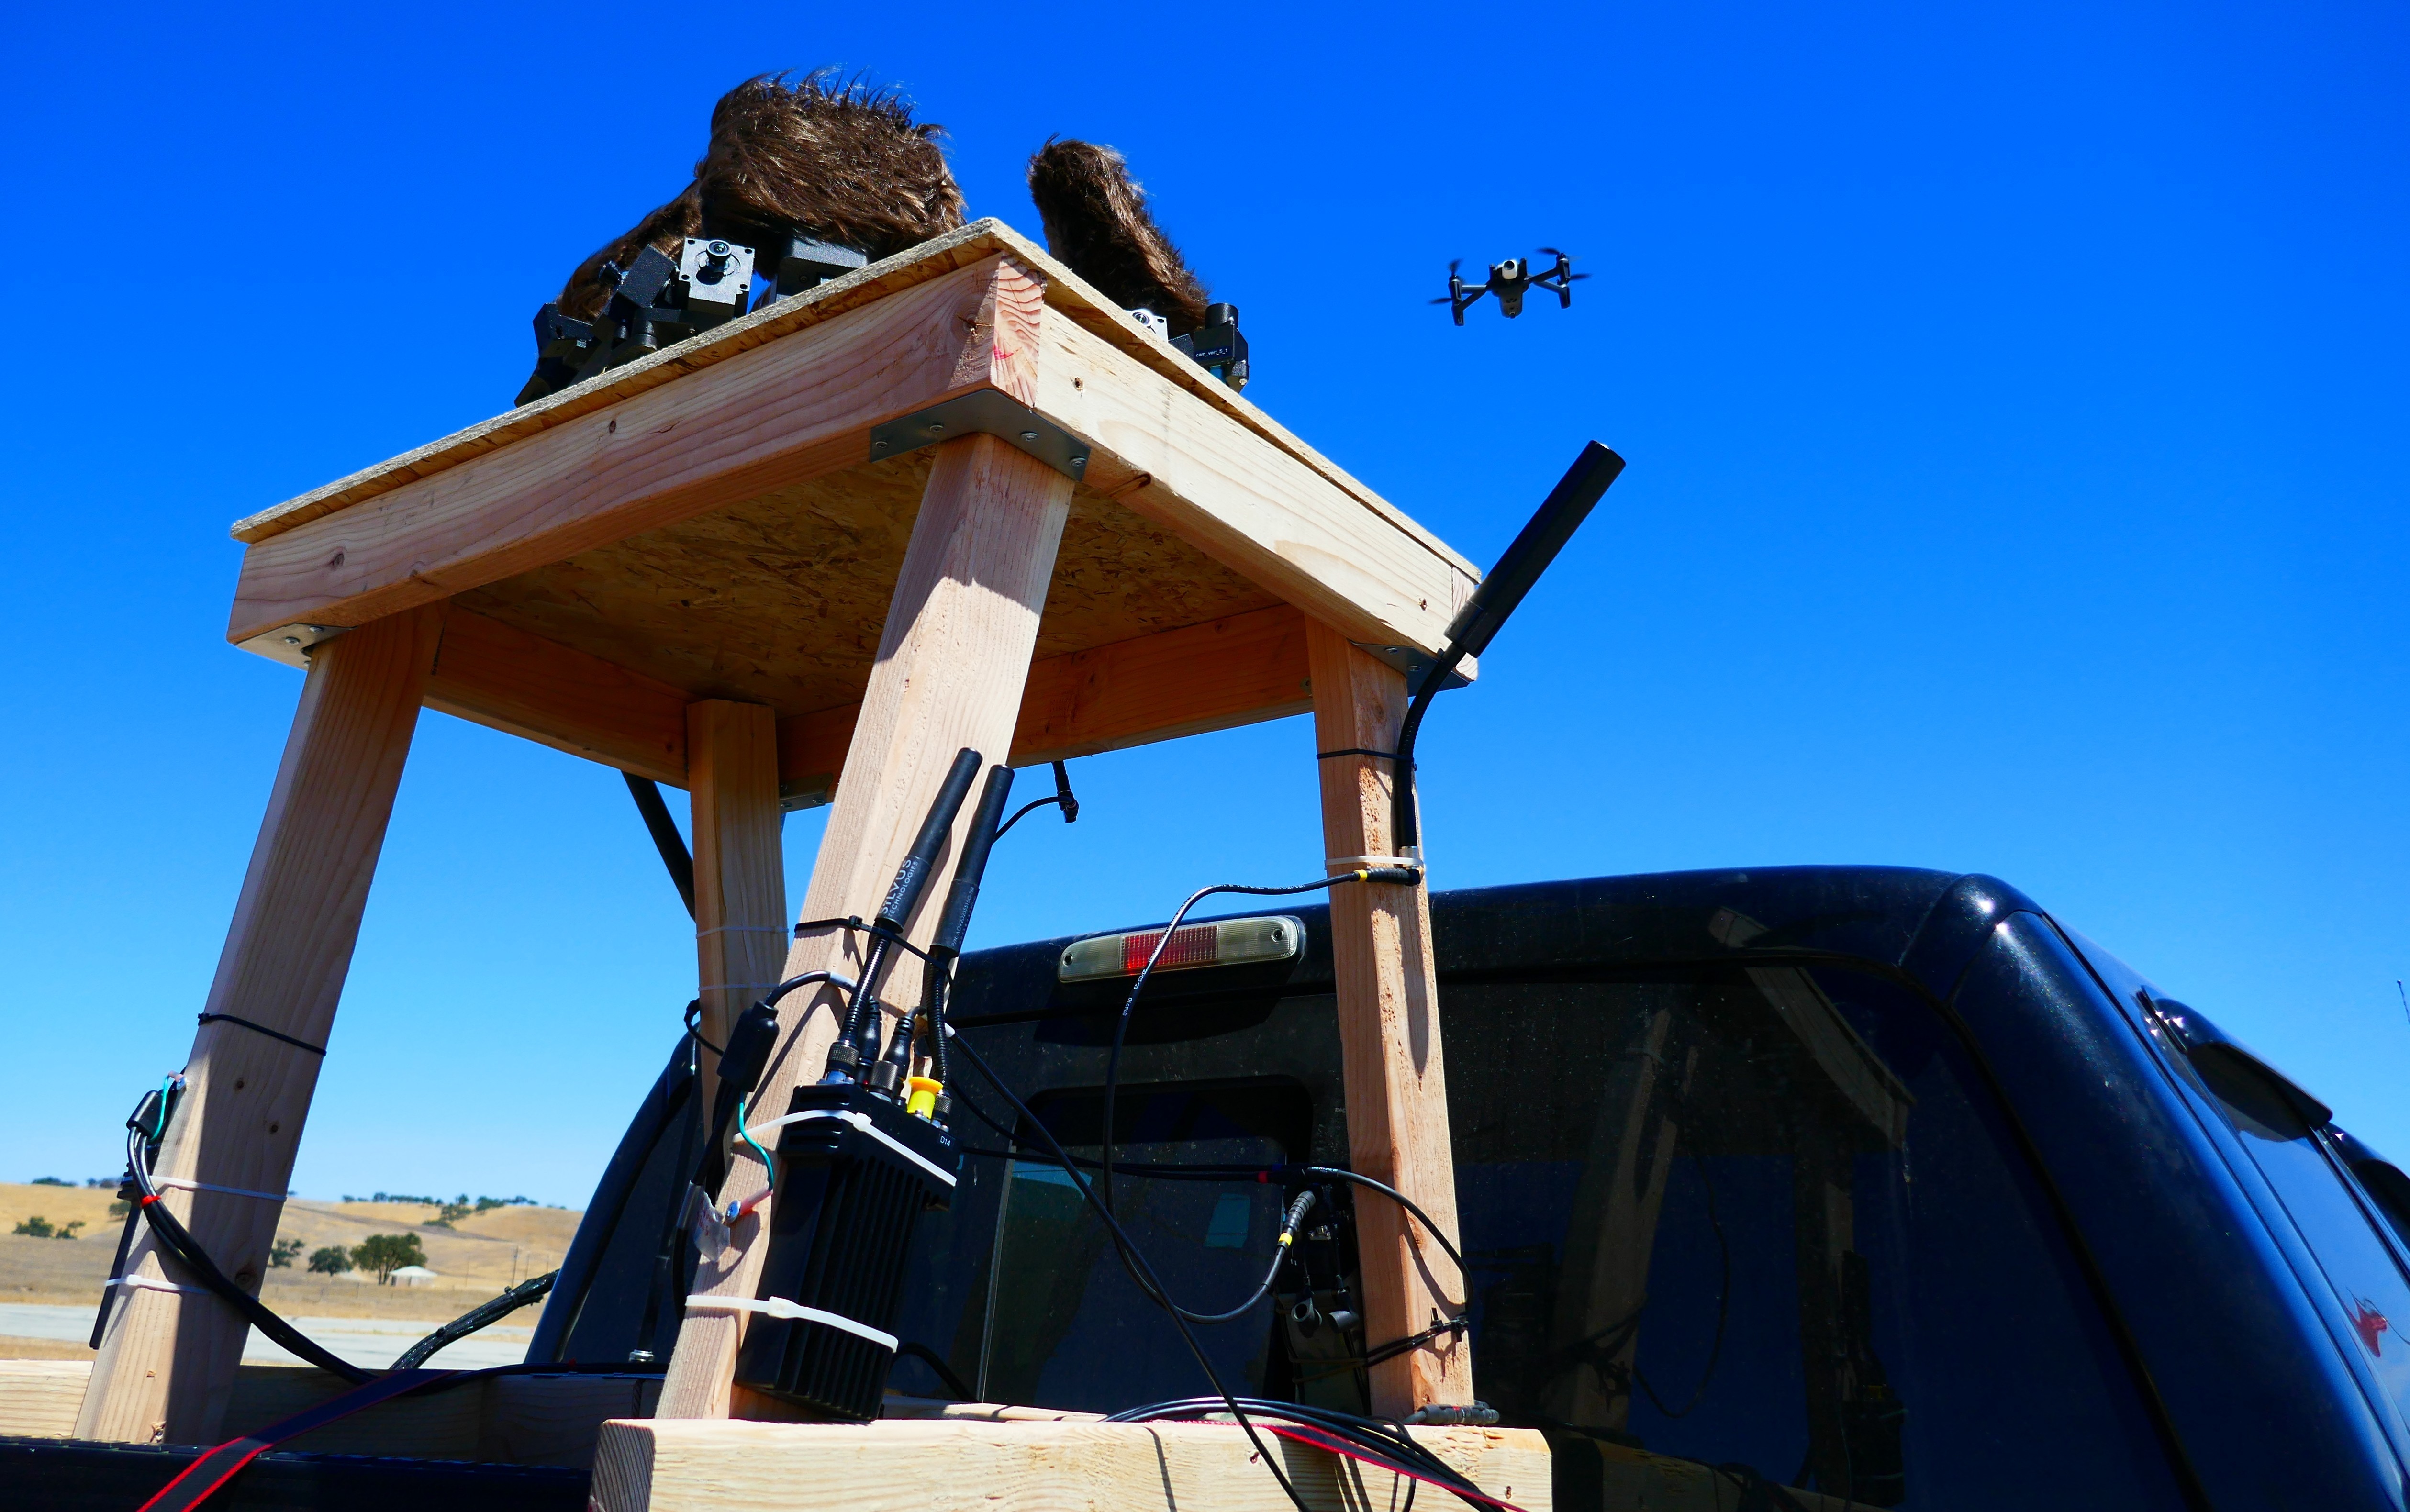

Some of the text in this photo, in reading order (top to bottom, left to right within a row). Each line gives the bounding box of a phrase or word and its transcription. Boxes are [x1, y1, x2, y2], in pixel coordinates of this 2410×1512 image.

[1196, 348, 1227, 357] cam_vert_5_1
[879, 859, 911, 914] SILVUS
[888, 861, 918, 916] TECHNOLOGIES
[940, 1135, 951, 1146] D14
